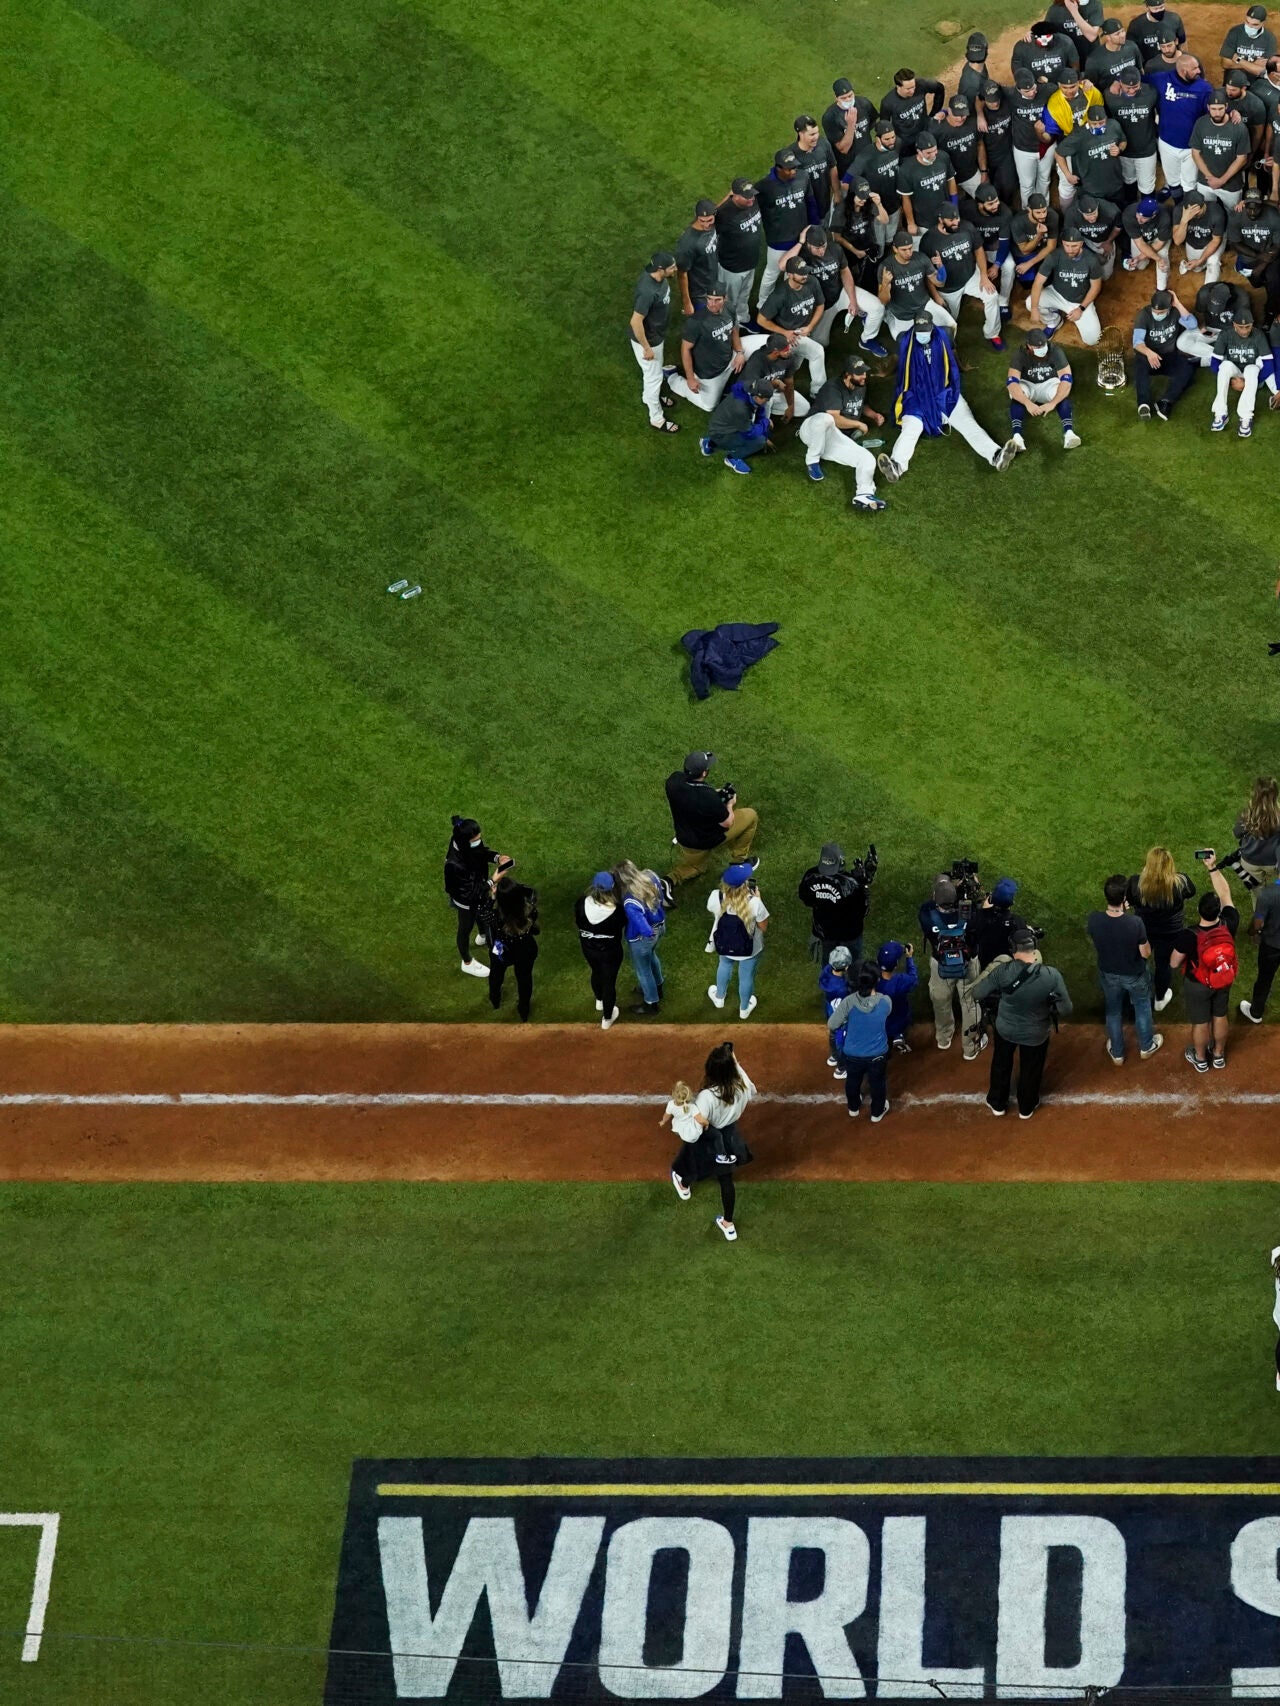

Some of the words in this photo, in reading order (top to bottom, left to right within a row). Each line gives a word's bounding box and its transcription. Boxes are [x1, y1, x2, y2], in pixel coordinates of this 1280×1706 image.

[1031, 57, 1061, 68] CHAMPIONS
[1166, 83, 1176, 101] LA
[900, 101, 924, 119] CHAMPIONS
[947, 133, 975, 148] CHAMPIONS
[809, 162, 827, 172] AMPIONS
[921, 172, 946, 186] CHAMPIONS
[776, 191, 804, 205] CHAMPIONS
[942, 241, 969, 257] CHAMPIONS
[811, 263, 838, 274] CHAMPIONS
[895, 272, 923, 286] CHAMPIONS
[791, 297, 815, 314] CHAMPIONS
[810, 883, 820, 891] LOS
[821, 883, 841, 900] ANGELES
[815, 891, 836, 904] DODGERS
[377, 1515, 1128, 1699] WORLD
